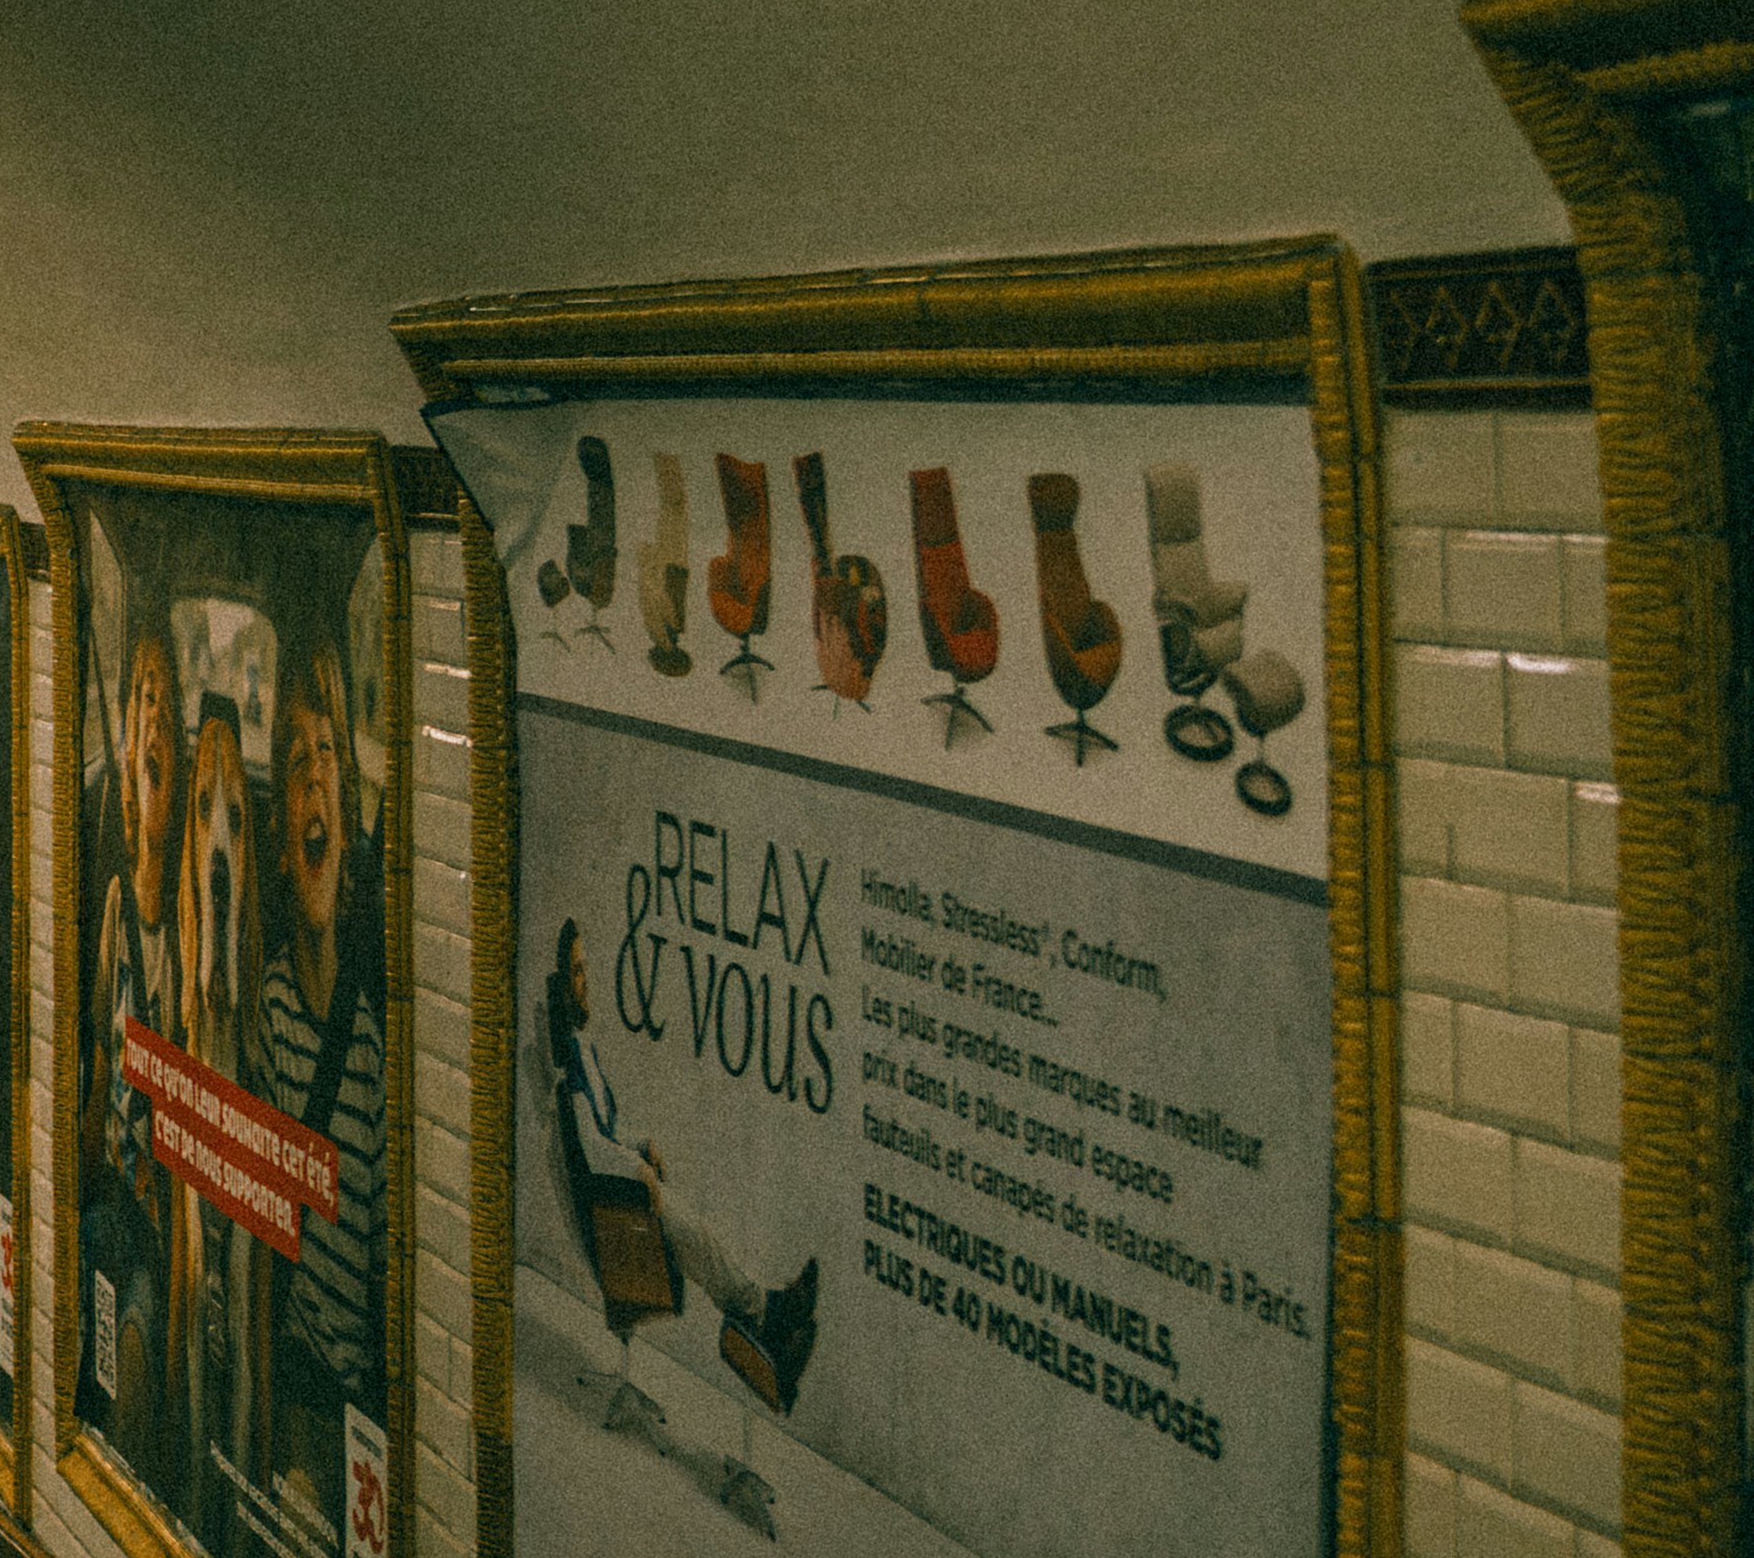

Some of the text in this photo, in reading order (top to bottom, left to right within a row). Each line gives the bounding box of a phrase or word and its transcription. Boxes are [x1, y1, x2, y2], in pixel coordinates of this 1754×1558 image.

[615, 863, 668, 1041] &
[655, 810, 830, 977] RELAX
[861, 925, 935, 982] Mobilier
[941, 954, 967, 995] de
[862, 984, 1263, 1172] Les plus grandes marques au meilleur
[862, 1048, 1173, 1205] prix dans le plus grand espace
[862, 1103, 941, 1172] fauteuils
[946, 1146, 967, 1183] et
[971, 1159, 1055, 1224] canapés
[1061, 1193, 1088, 1239] de
[1094, 1213, 1213, 1295] relaxation
[1219, 1259, 1237, 1305] à
[864, 1183, 1181, 1382] ELECTRIQUES OU MANUELS,
[864, 1239, 1222, 1461] PLUS DE 40 MODÈLES EXPOSÉS
